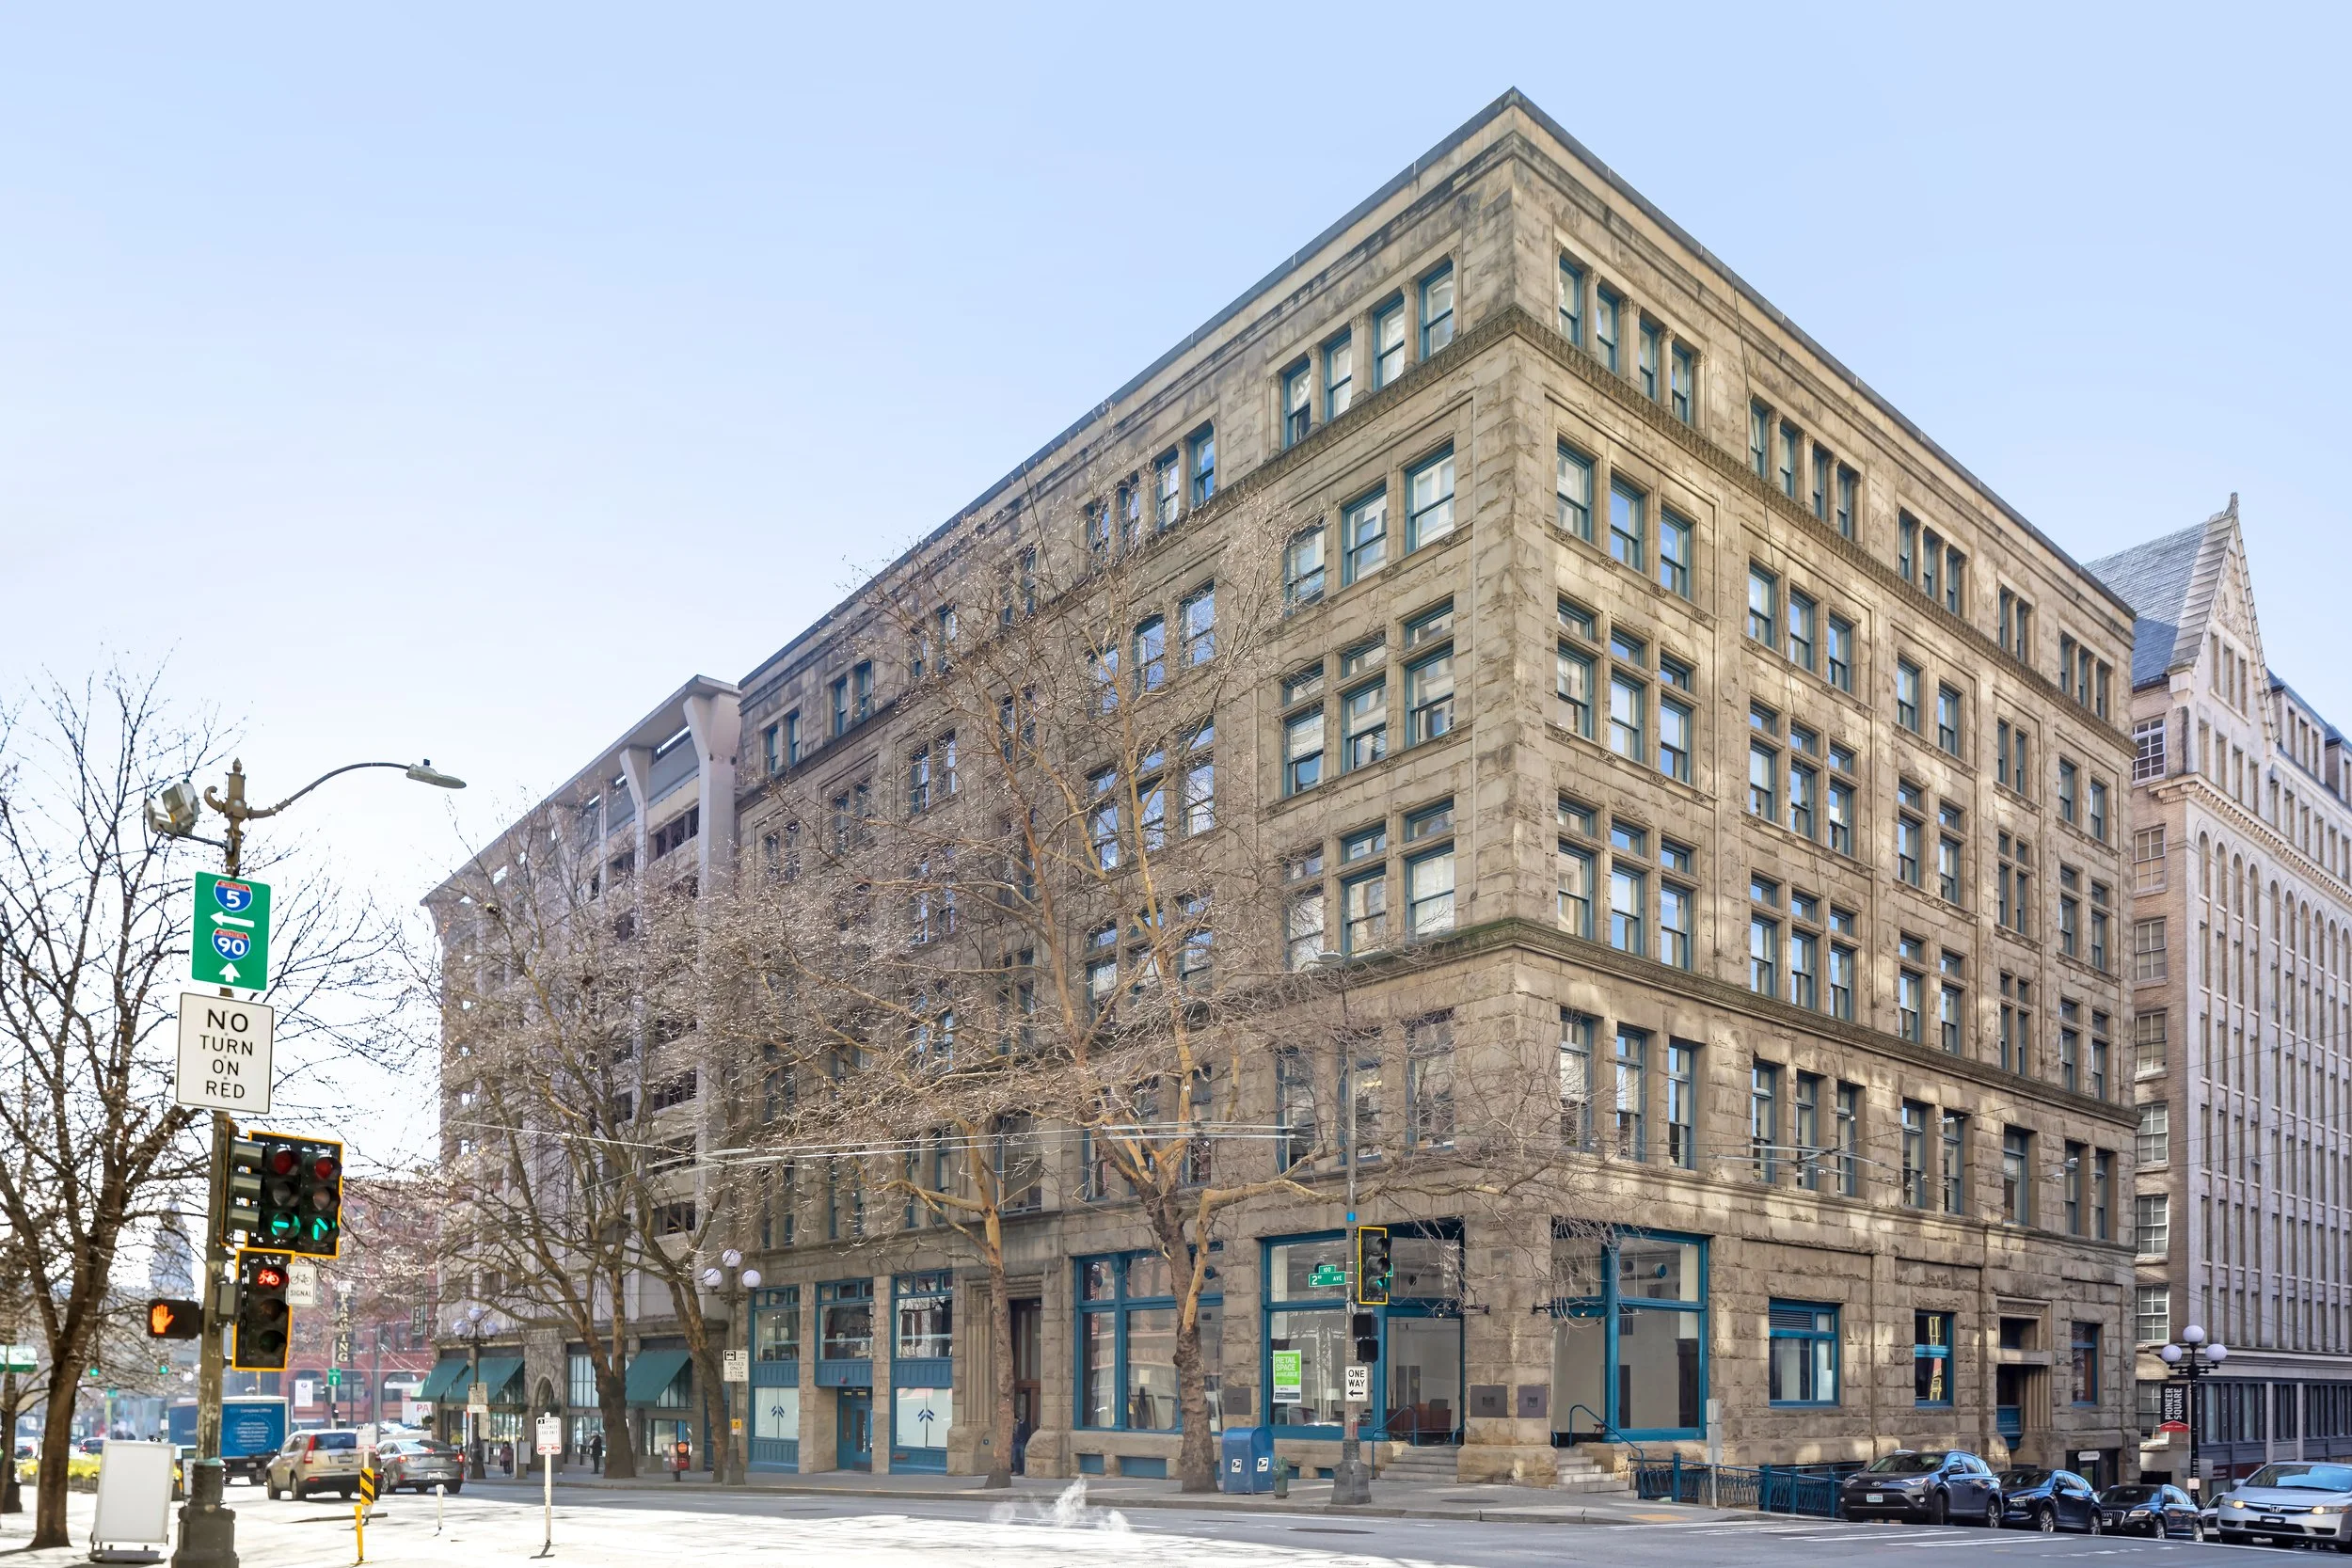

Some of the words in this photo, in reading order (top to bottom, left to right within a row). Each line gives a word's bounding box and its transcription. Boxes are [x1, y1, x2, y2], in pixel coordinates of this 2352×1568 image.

[226, 890, 241, 909] 5
[217, 937, 246, 956] 90
[207, 1008, 248, 1033] NO
[199, 1034, 253, 1056] TURN
[212, 1058, 239, 1076] ON
[205, 1080, 245, 1099] RED
[290, 1290, 311, 1298] SIGNAL
[1275, 1355, 1296, 1364] RETAIL
[1348, 1370, 1364, 1378] ONE
[1348, 1379, 1365, 1387] WAY
[2164, 1387, 2173, 1420] PIONEER
[2173, 1387, 2183, 1420] SQUARE
